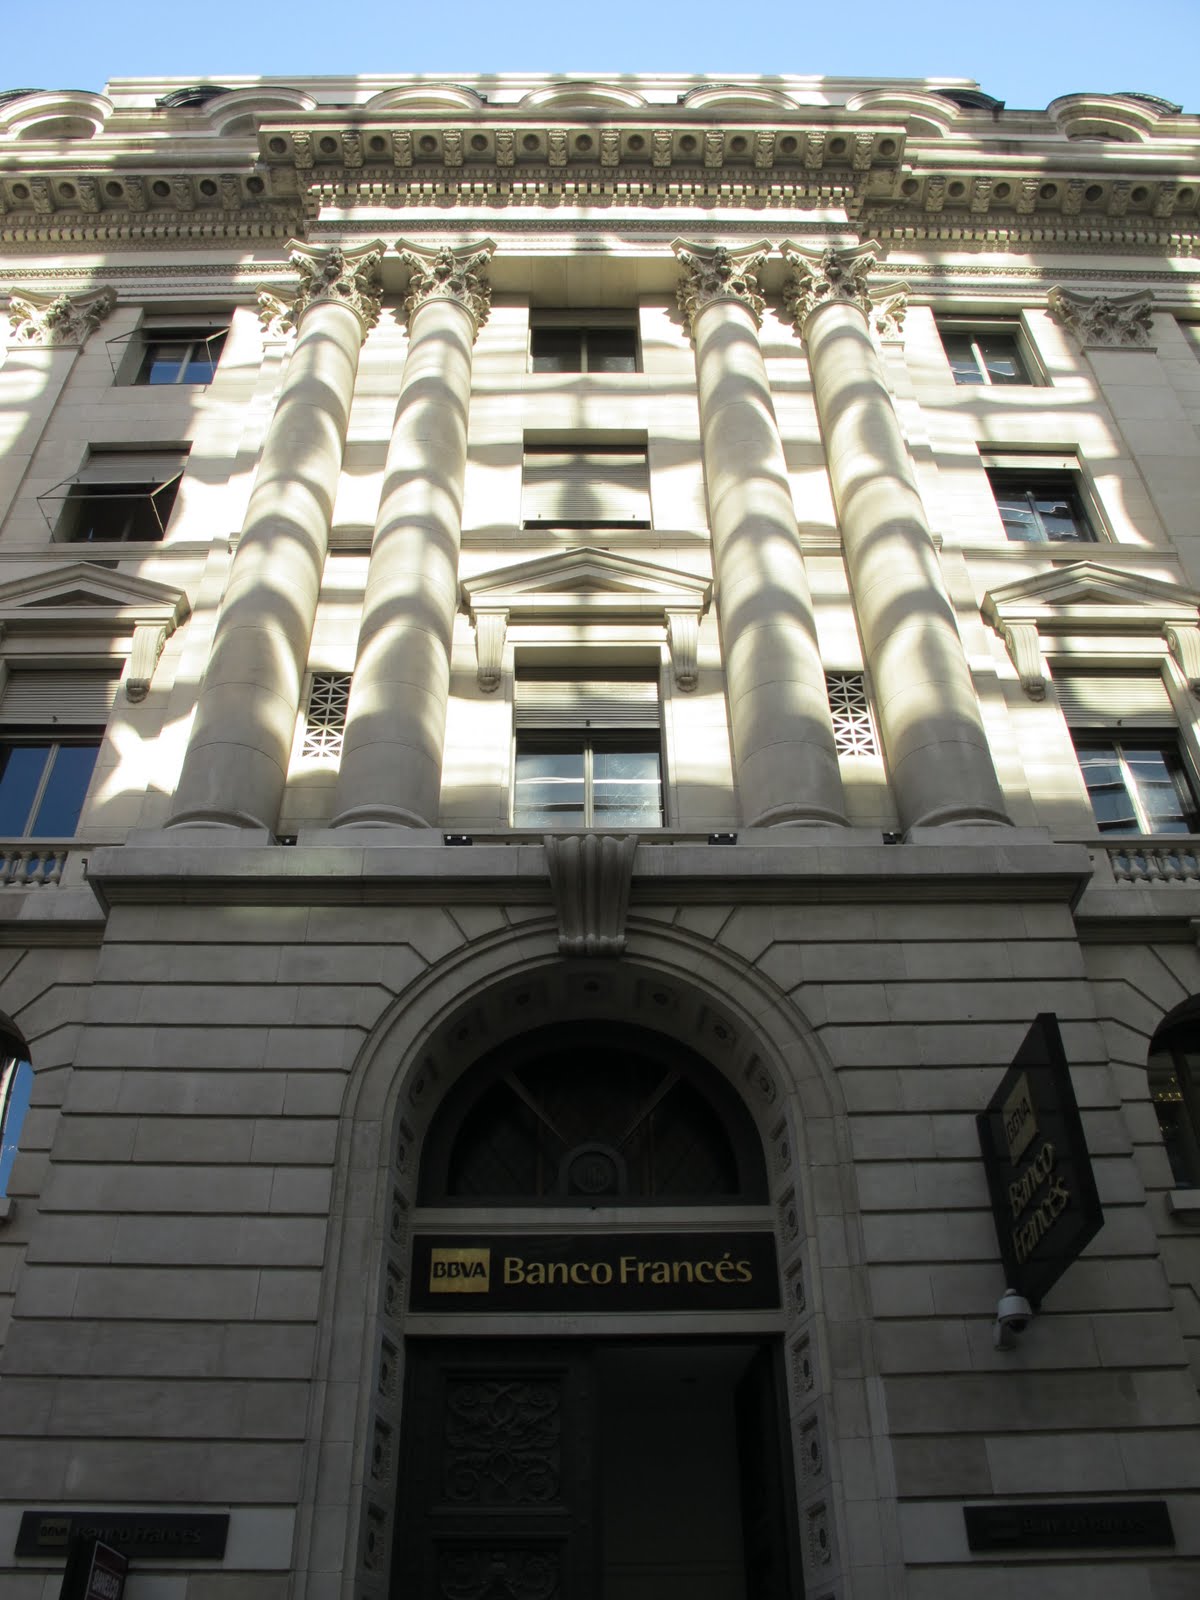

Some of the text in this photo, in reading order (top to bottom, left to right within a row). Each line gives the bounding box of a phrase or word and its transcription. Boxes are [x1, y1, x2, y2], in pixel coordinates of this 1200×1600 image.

[1006, 1097, 1032, 1144] BBVA
[1008, 1142, 1056, 1218] Banco
[1012, 1175, 1072, 1265] Francés
[433, 1252, 753, 1286] BBVA Banco Francés
